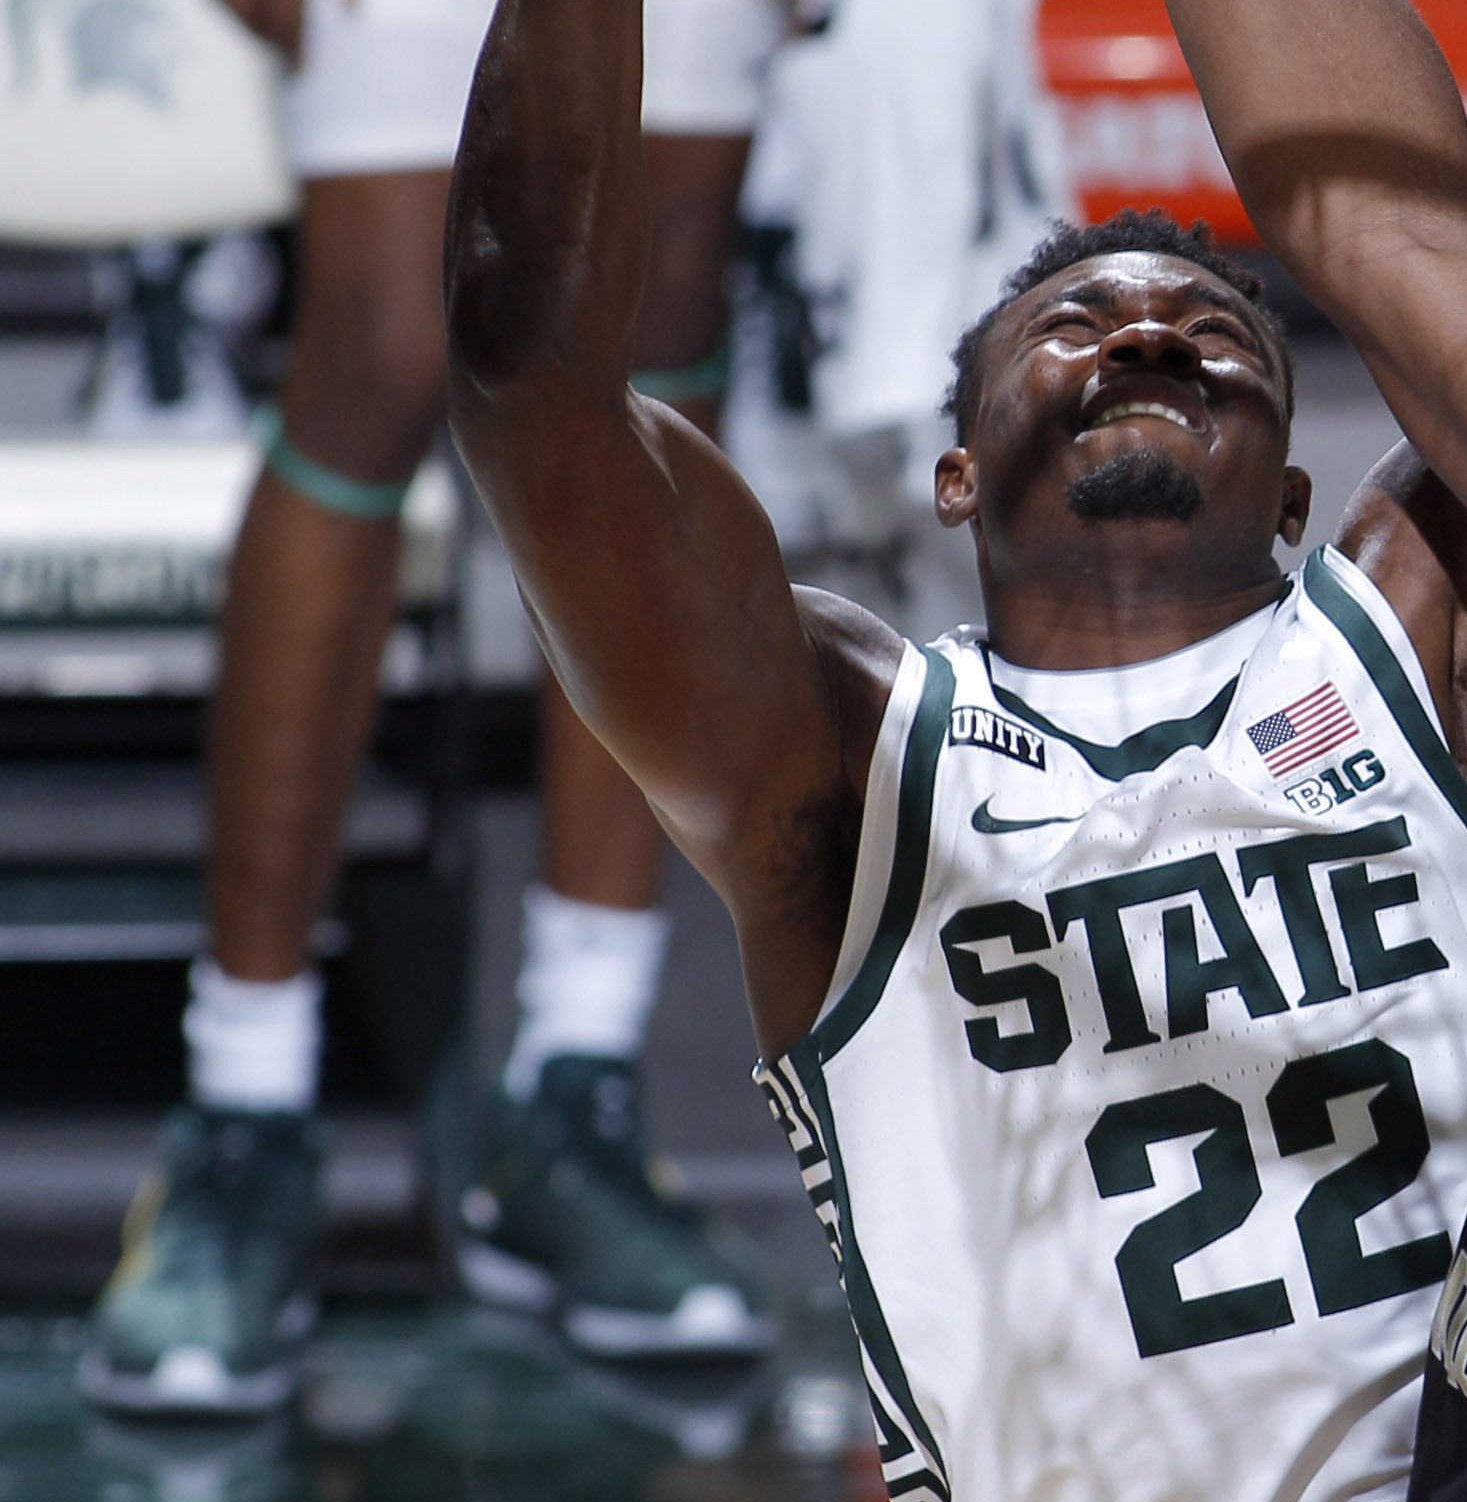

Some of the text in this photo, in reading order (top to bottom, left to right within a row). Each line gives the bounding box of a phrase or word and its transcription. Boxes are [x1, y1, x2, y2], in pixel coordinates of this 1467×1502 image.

[951, 707, 1042, 764] UNITY
[939, 814, 1450, 1073] STATE
[1084, 1037, 1454, 1358] 22
